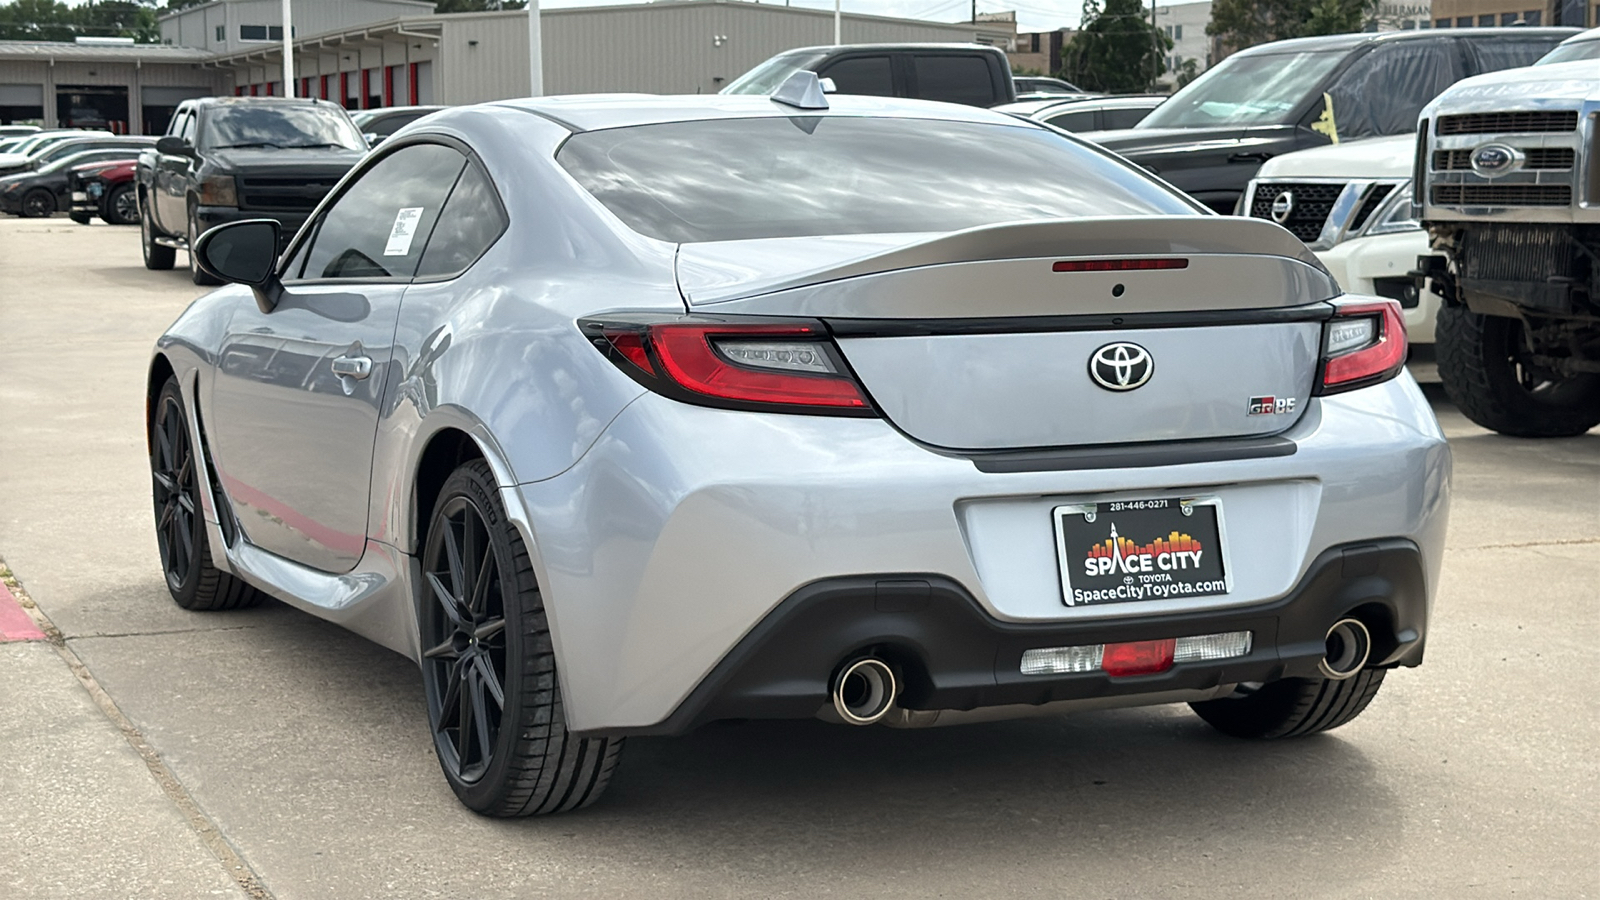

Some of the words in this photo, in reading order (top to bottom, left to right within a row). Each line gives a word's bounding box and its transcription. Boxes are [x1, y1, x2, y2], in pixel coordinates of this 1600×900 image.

[1110, 500, 1168, 511] 281-446-0271
[1084, 550, 1153, 576] SPACE
[1157, 550, 1202, 571] CITY
[1138, 573, 1172, 583] TOYOTA
[1074, 579, 1226, 604] SpaceCityToyota.com
